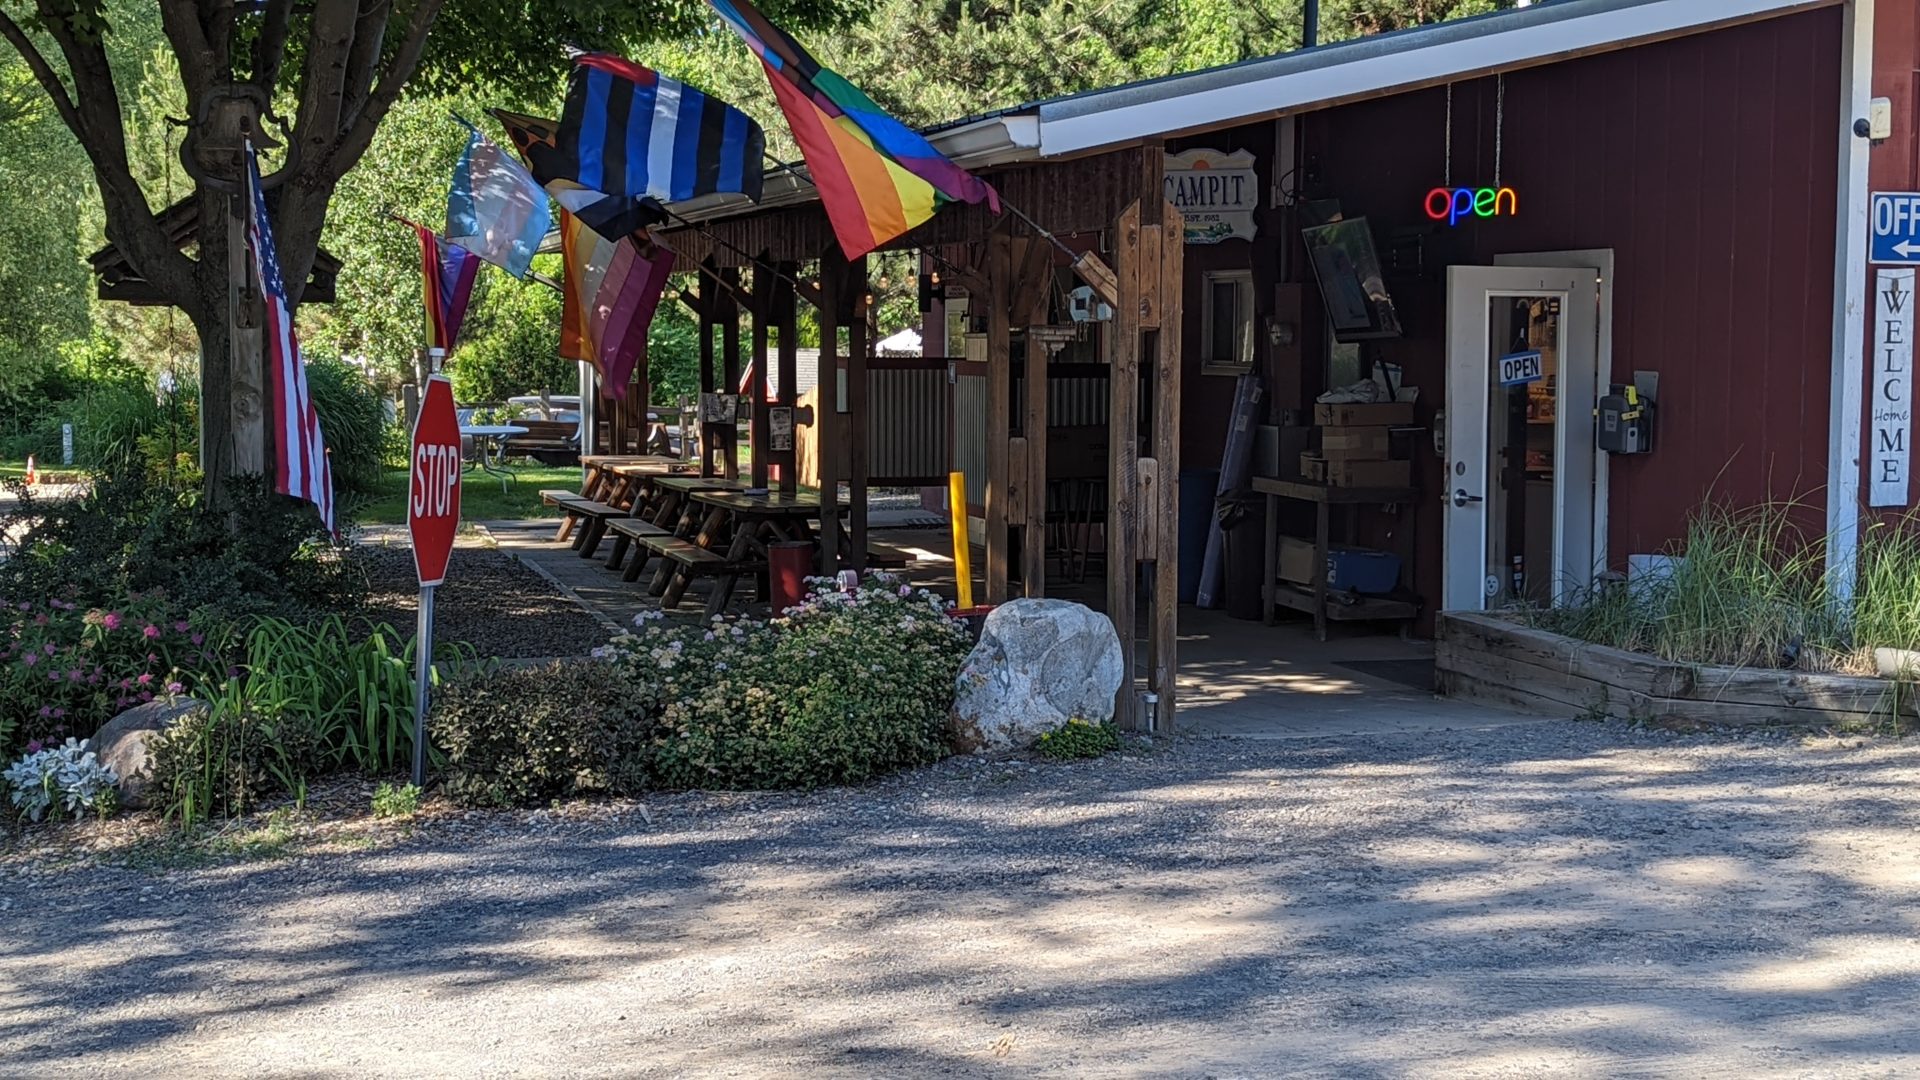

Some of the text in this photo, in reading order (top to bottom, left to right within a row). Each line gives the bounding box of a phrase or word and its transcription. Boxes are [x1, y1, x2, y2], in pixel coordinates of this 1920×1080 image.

[1163, 175, 1244, 207] CAMPIT
[1425, 188, 1516, 226] open
[1504, 357, 1539, 380] OPEN
[1875, 408, 1909, 421] Home
[414, 443, 458, 518] STOP
